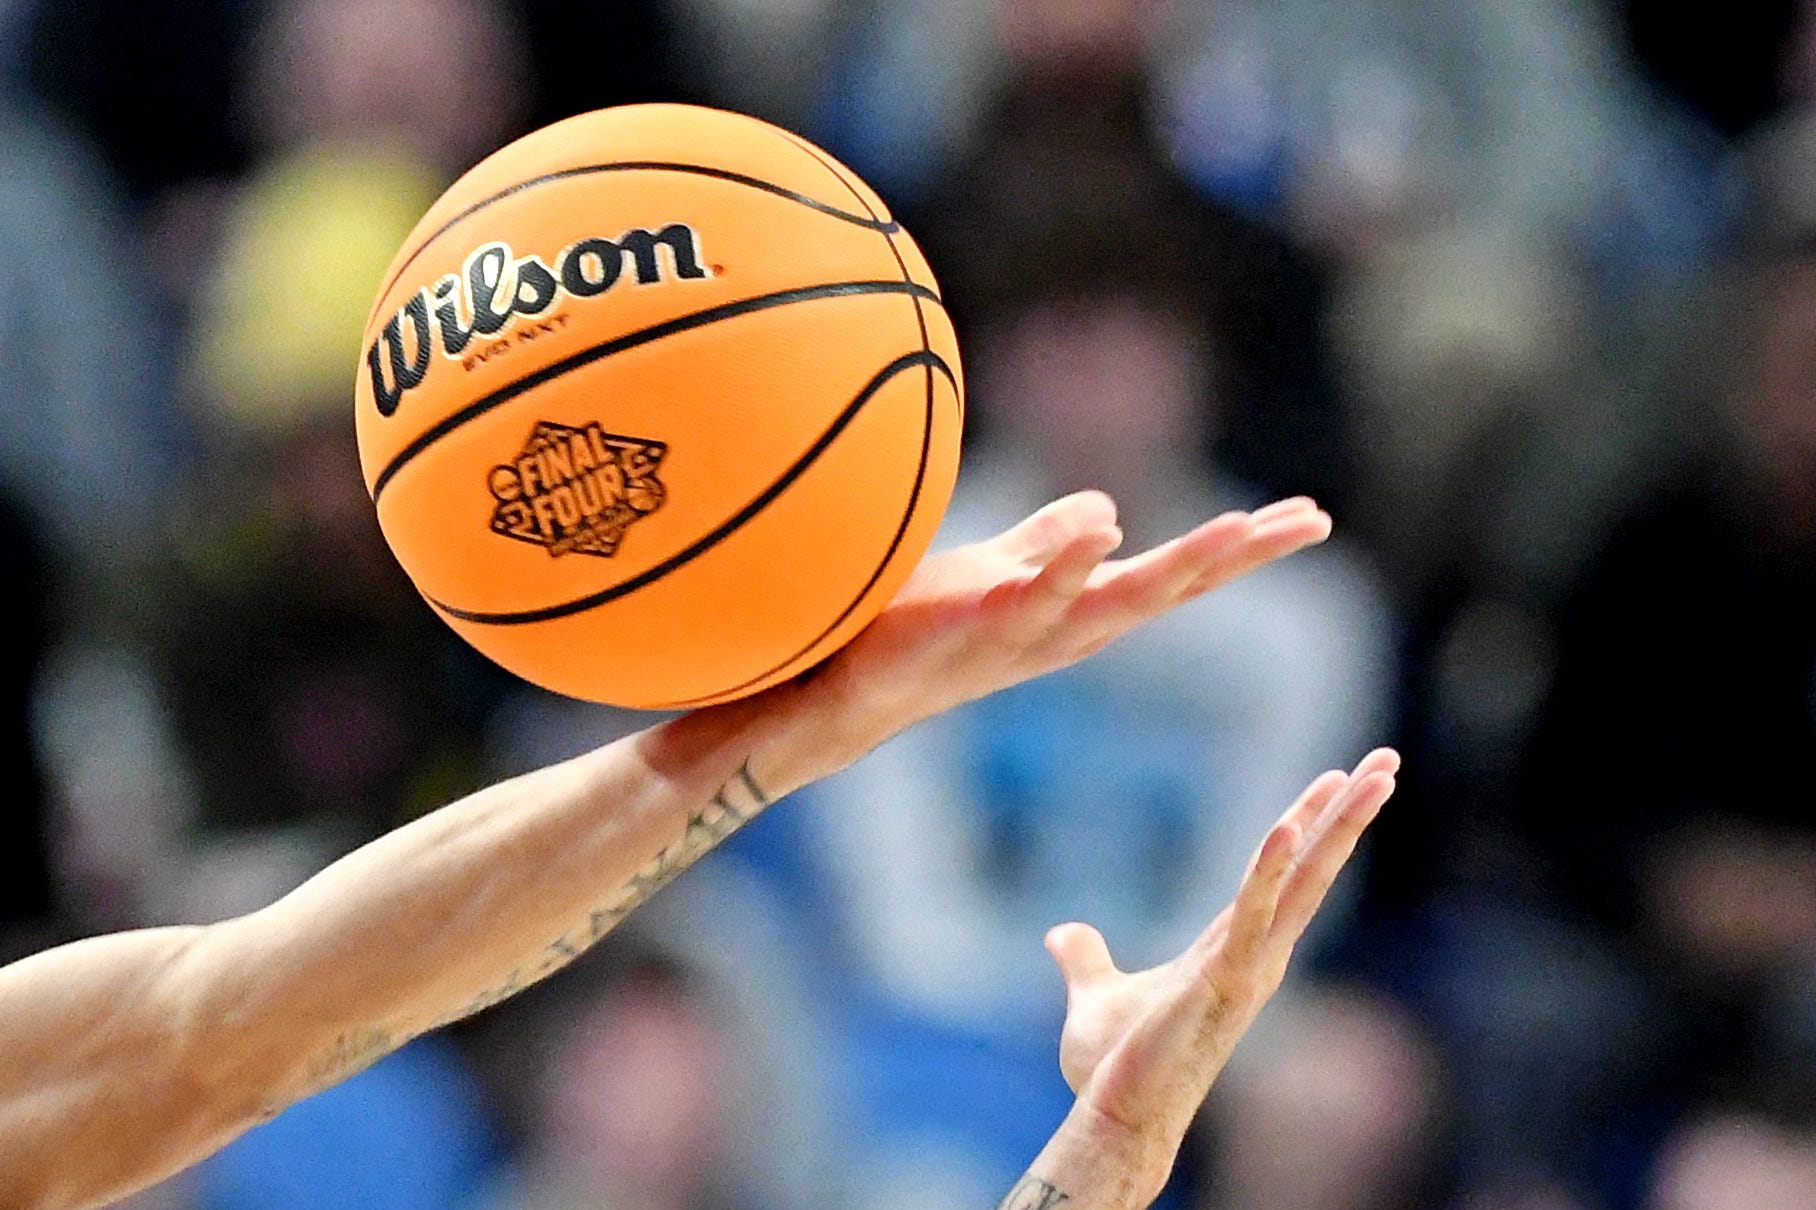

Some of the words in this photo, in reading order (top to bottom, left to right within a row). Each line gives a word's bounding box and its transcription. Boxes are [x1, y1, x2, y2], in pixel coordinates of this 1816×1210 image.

[367, 222, 708, 417] Wilson
[517, 422, 615, 498] FINAL
[533, 462, 625, 541] FOUR
